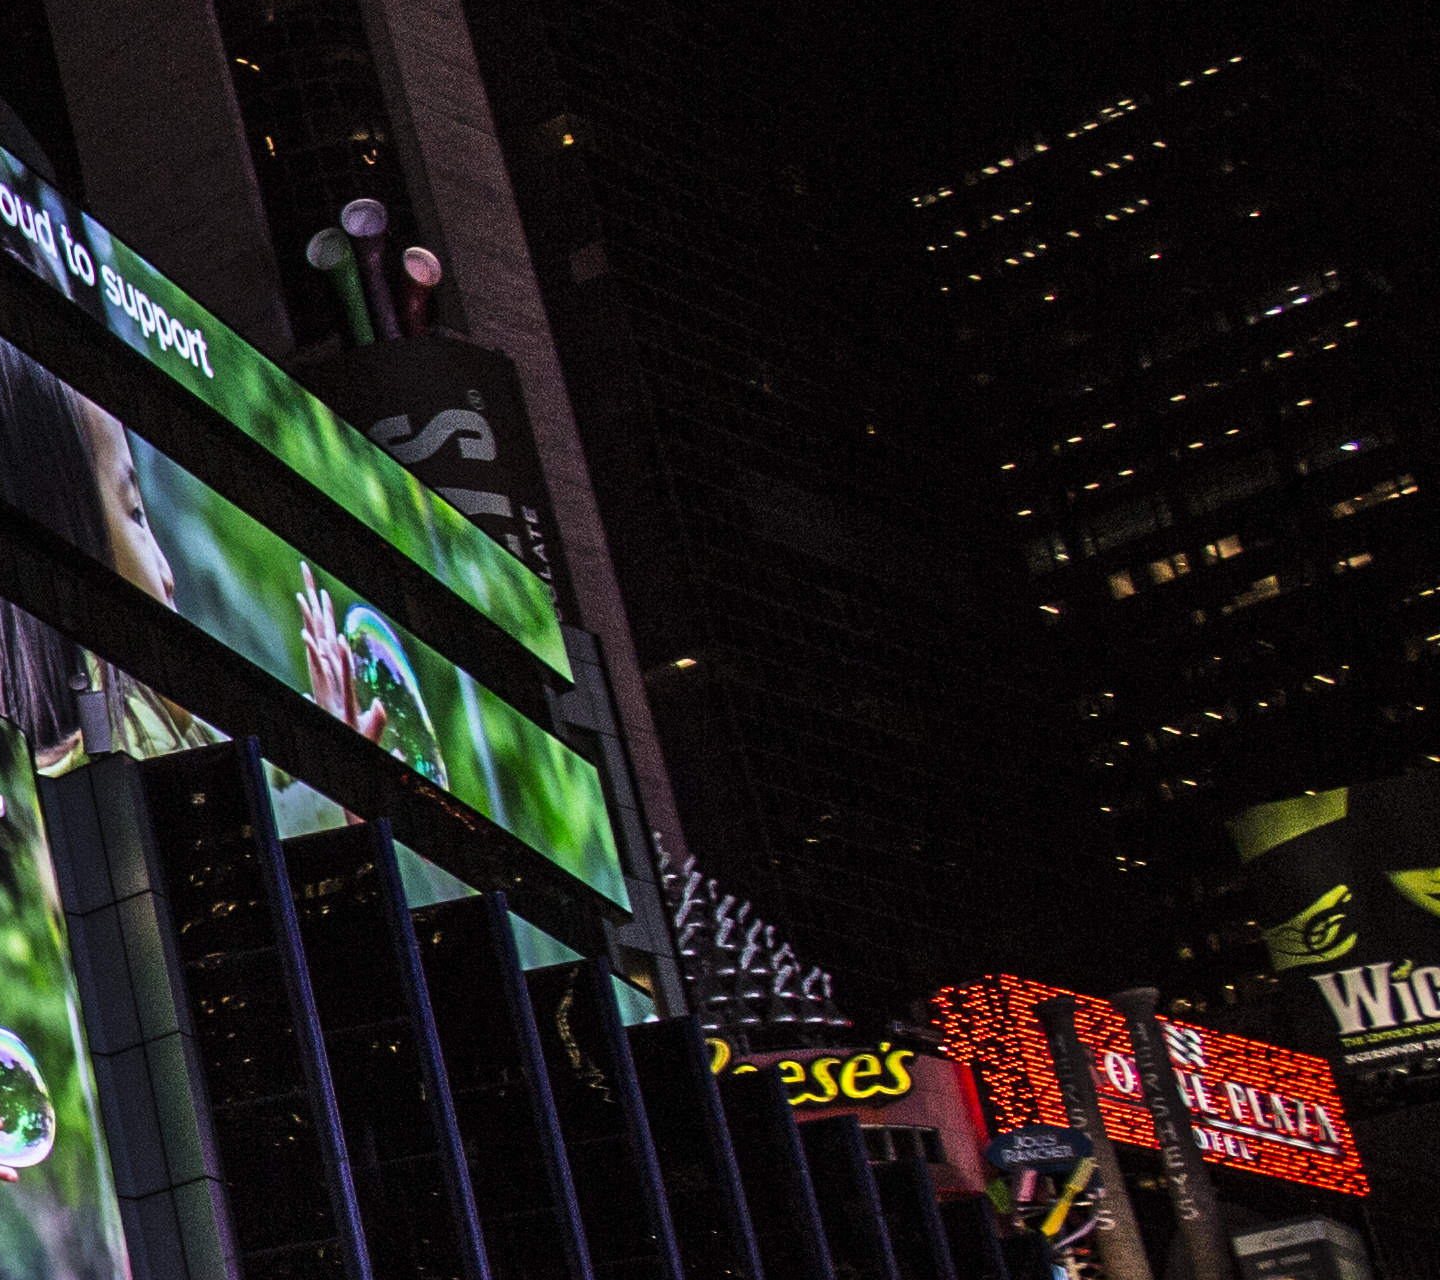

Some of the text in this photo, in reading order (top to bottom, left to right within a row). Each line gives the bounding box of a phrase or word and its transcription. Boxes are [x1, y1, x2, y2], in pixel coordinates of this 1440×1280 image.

[60, 223, 96, 286] to
[101, 264, 216, 380] support
[1192, 1126, 1254, 1162] OTEL
